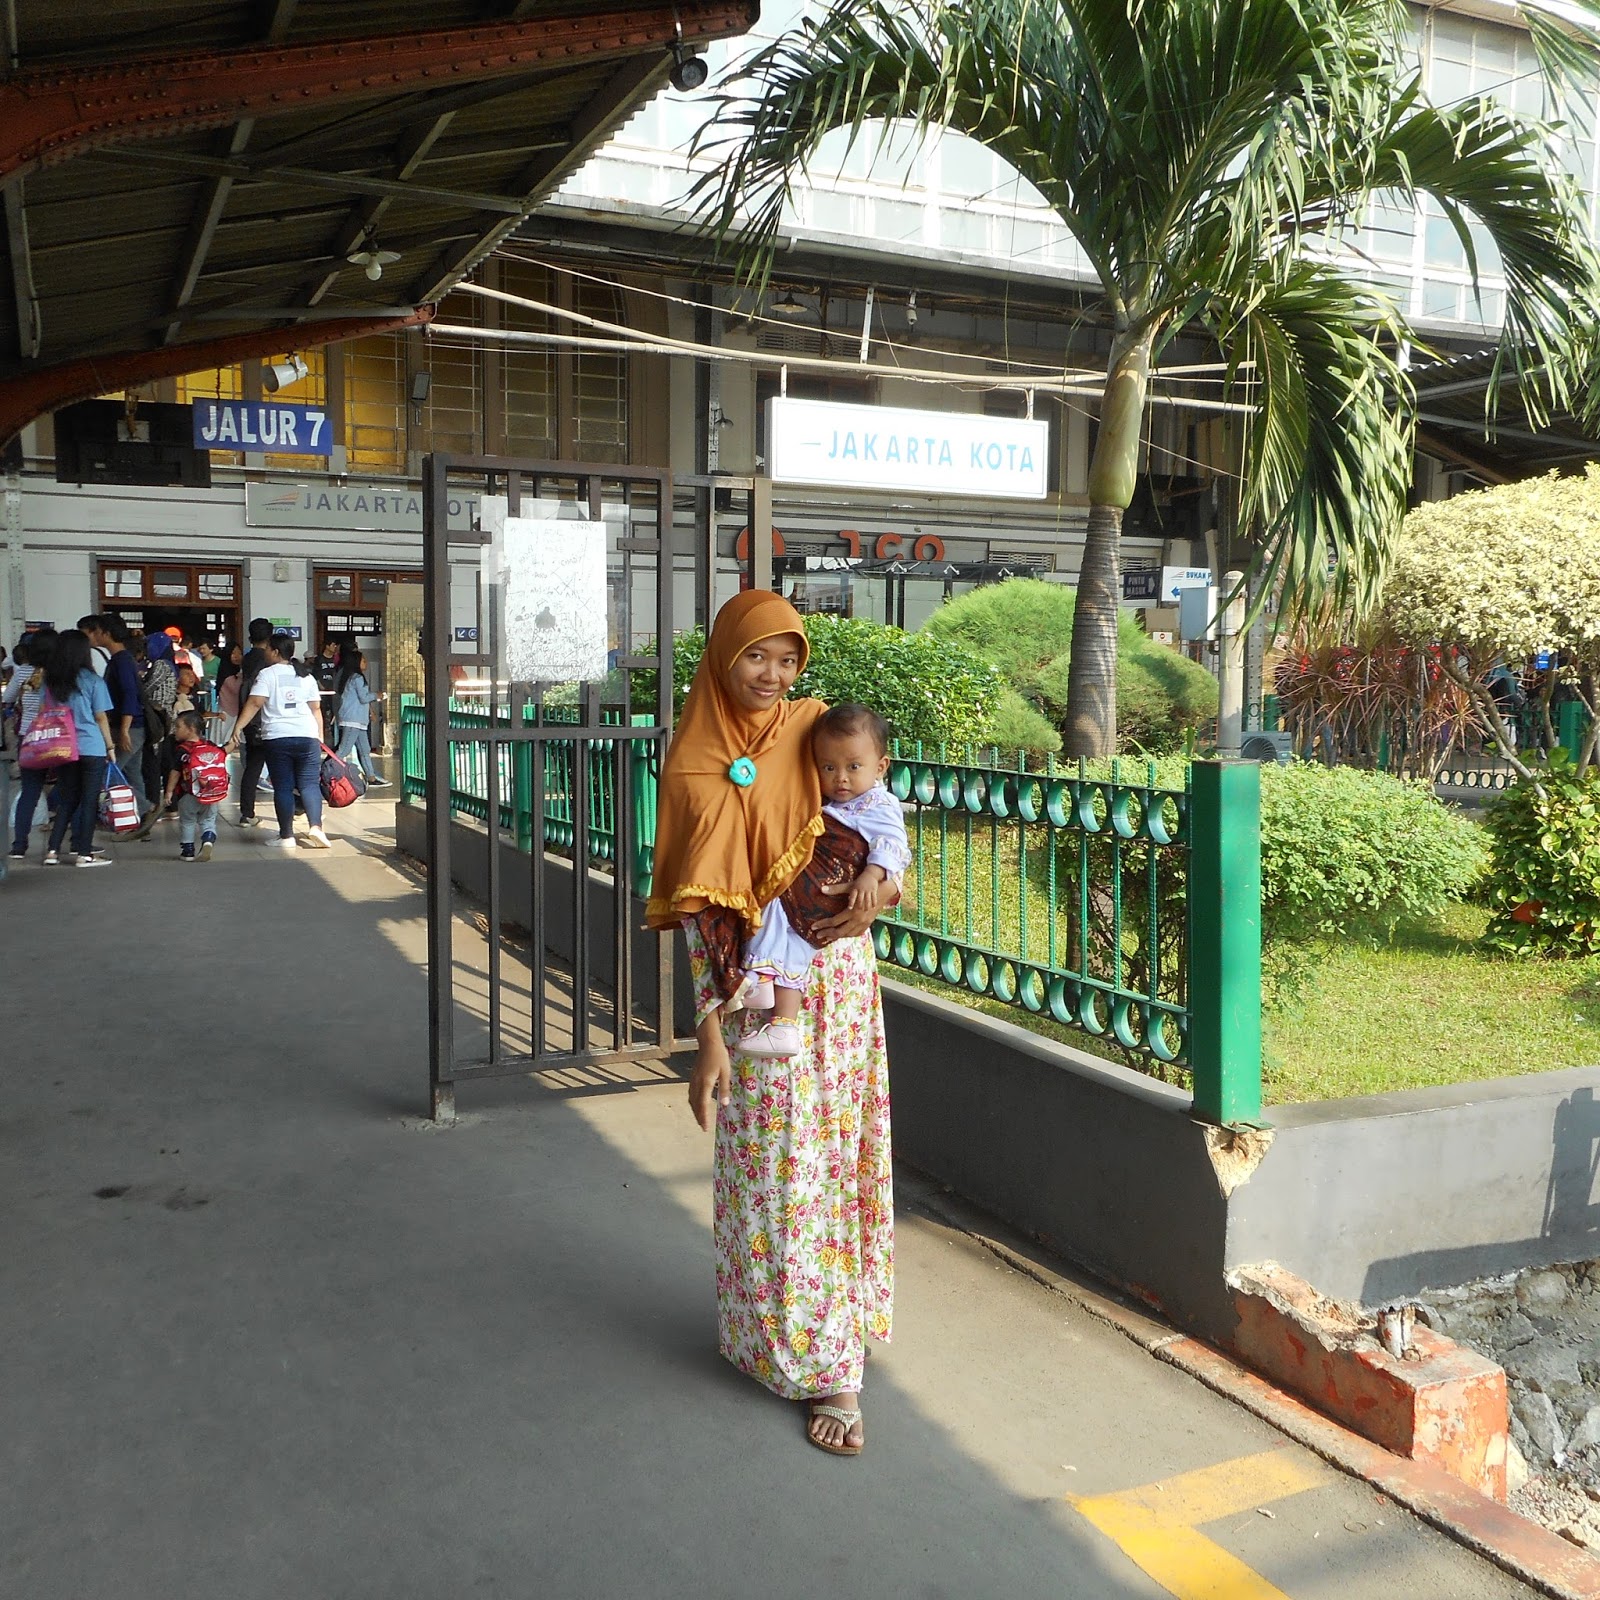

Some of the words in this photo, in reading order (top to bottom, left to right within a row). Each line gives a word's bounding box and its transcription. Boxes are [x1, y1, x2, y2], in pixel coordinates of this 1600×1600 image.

[201, 405, 298, 446] JALUR
[305, 412, 325, 447] 7
[828, 430, 953, 466] JAKARTA
[970, 442, 1034, 473] KOTA
[303, 492, 420, 515] JAKARTA
